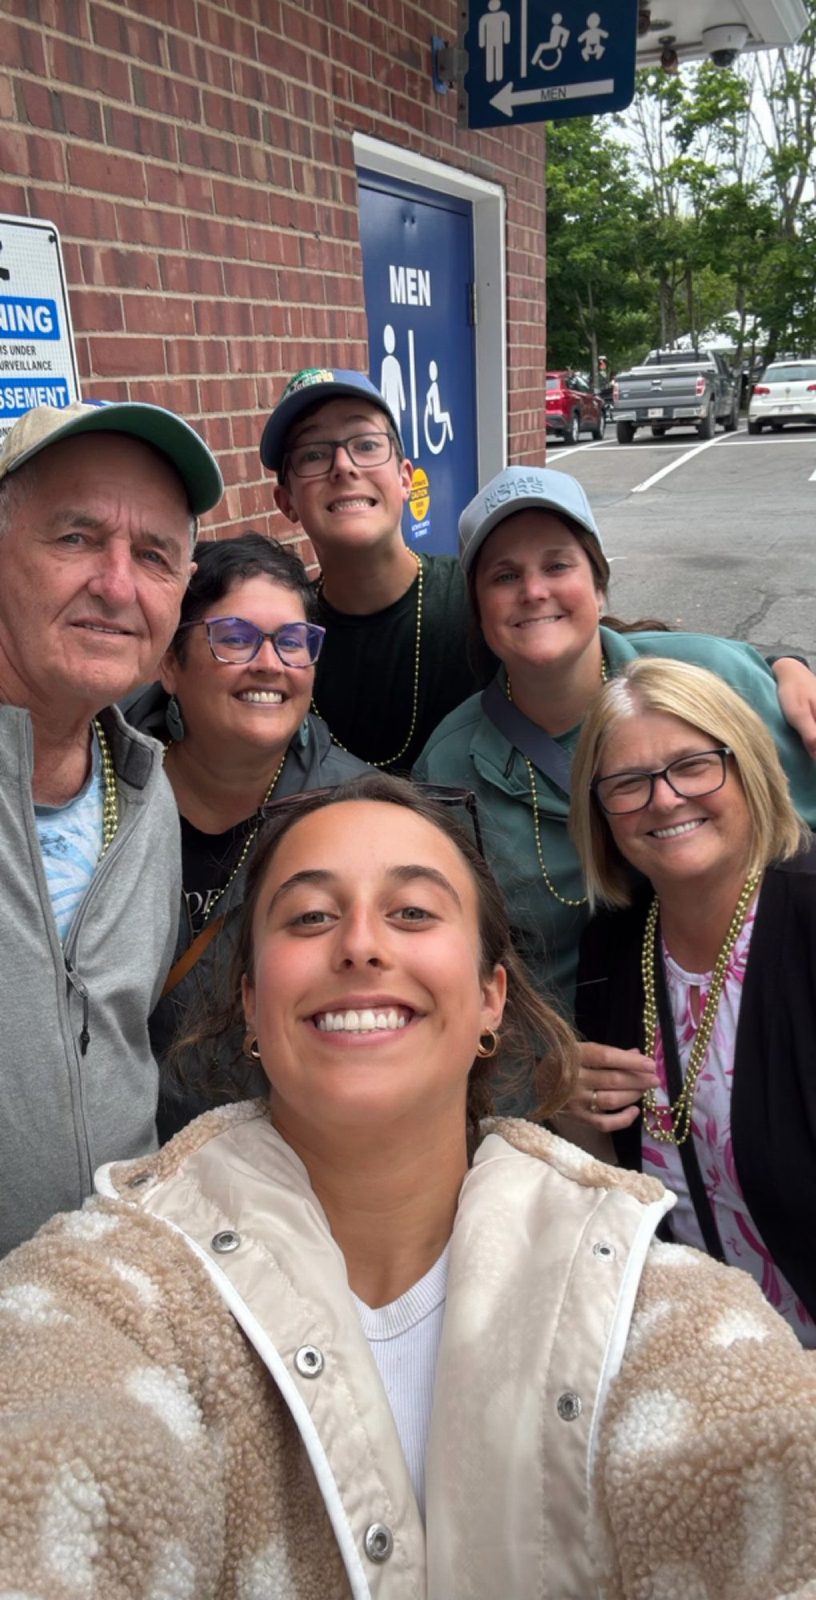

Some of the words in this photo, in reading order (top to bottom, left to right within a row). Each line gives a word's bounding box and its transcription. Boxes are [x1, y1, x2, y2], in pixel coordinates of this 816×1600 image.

[540, 87, 567, 100] MEN
[389, 265, 431, 307] MEN
[9, 345, 37, 356] UNDER
